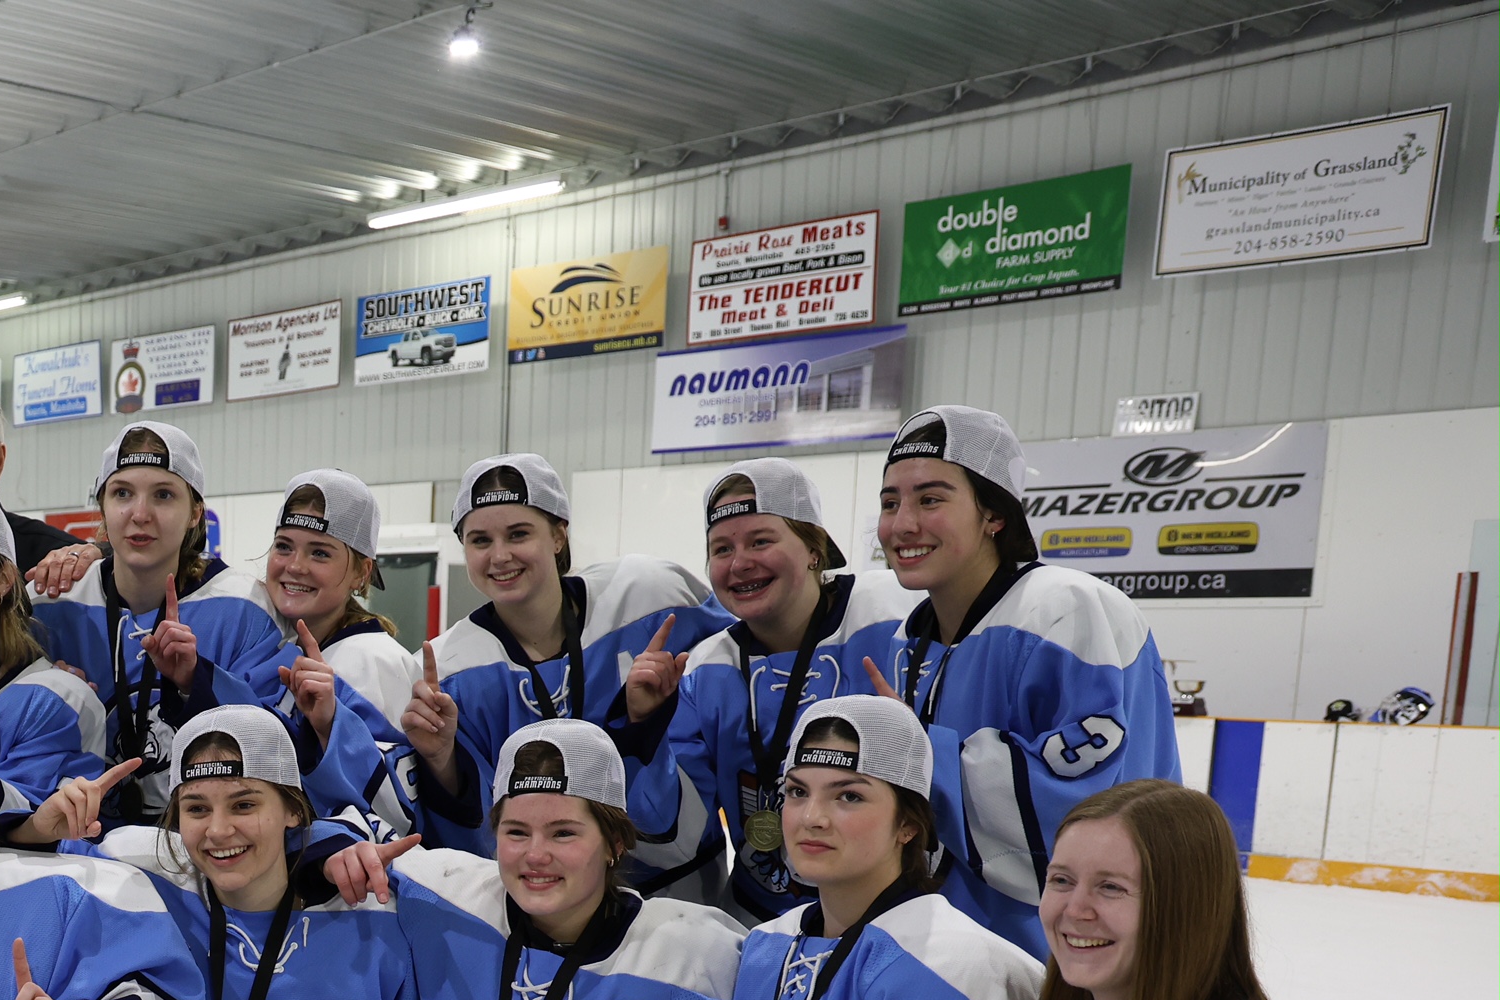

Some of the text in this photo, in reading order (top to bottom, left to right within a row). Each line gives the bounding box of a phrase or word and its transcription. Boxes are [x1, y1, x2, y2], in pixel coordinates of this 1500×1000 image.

[1186, 171, 1291, 197] Municipality
[1293, 169, 1308, 181] of
[1314, 151, 1398, 178] Grassland
[937, 197, 1018, 236] double
[1250, 205, 1273, 215] Hour
[1275, 199, 1298, 214] from
[985, 211, 1091, 254] diamond
[1205, 207, 1380, 241] grasslandmunicipality.ca
[702, 219, 866, 260] Prairie Rose Meats
[1234, 228, 1345, 255] 204-858-2590
[714, 273, 728, 283] use
[730, 268, 755, 282] locally
[756, 265, 781, 277] grown
[806, 258, 826, 269] Pork
[828, 256, 835, 265] &
[837, 253, 863, 264] Bison
[745, 251, 784, 264] Manitoba
[996, 246, 1076, 269] FARM SUPPLY
[1006, 275, 1020, 288] for
[1023, 272, 1045, 287] Crop
[365, 281, 484, 320] SOUTHWEST
[699, 272, 864, 312] The TENDERCUT
[530, 285, 641, 329] SUNRISE
[549, 309, 642, 328] CREDIT UNION
[721, 296, 835, 325] Meat & Deli
[231, 320, 273, 336] Morrison
[276, 310, 320, 332] Agencies
[367, 306, 480, 334] CHEVROLET BUICK GMC
[593, 335, 657, 353] sunrisecu.mb.ca
[59, 375, 97, 396] Home
[669, 361, 811, 397] naumann
[120, 456, 161, 465] CHAMPIONS
[892, 444, 939, 456] CHAMPIONS
[476, 493, 519, 505] CHAMPIONS
[285, 517, 325, 531] CHAMPIONS
[710, 504, 749, 522] CHAMPIONS
[185, 766, 233, 778] CHAMPIONS
[801, 754, 853, 767] CHAMPIONS
[514, 780, 562, 789] CHAMPIONS
